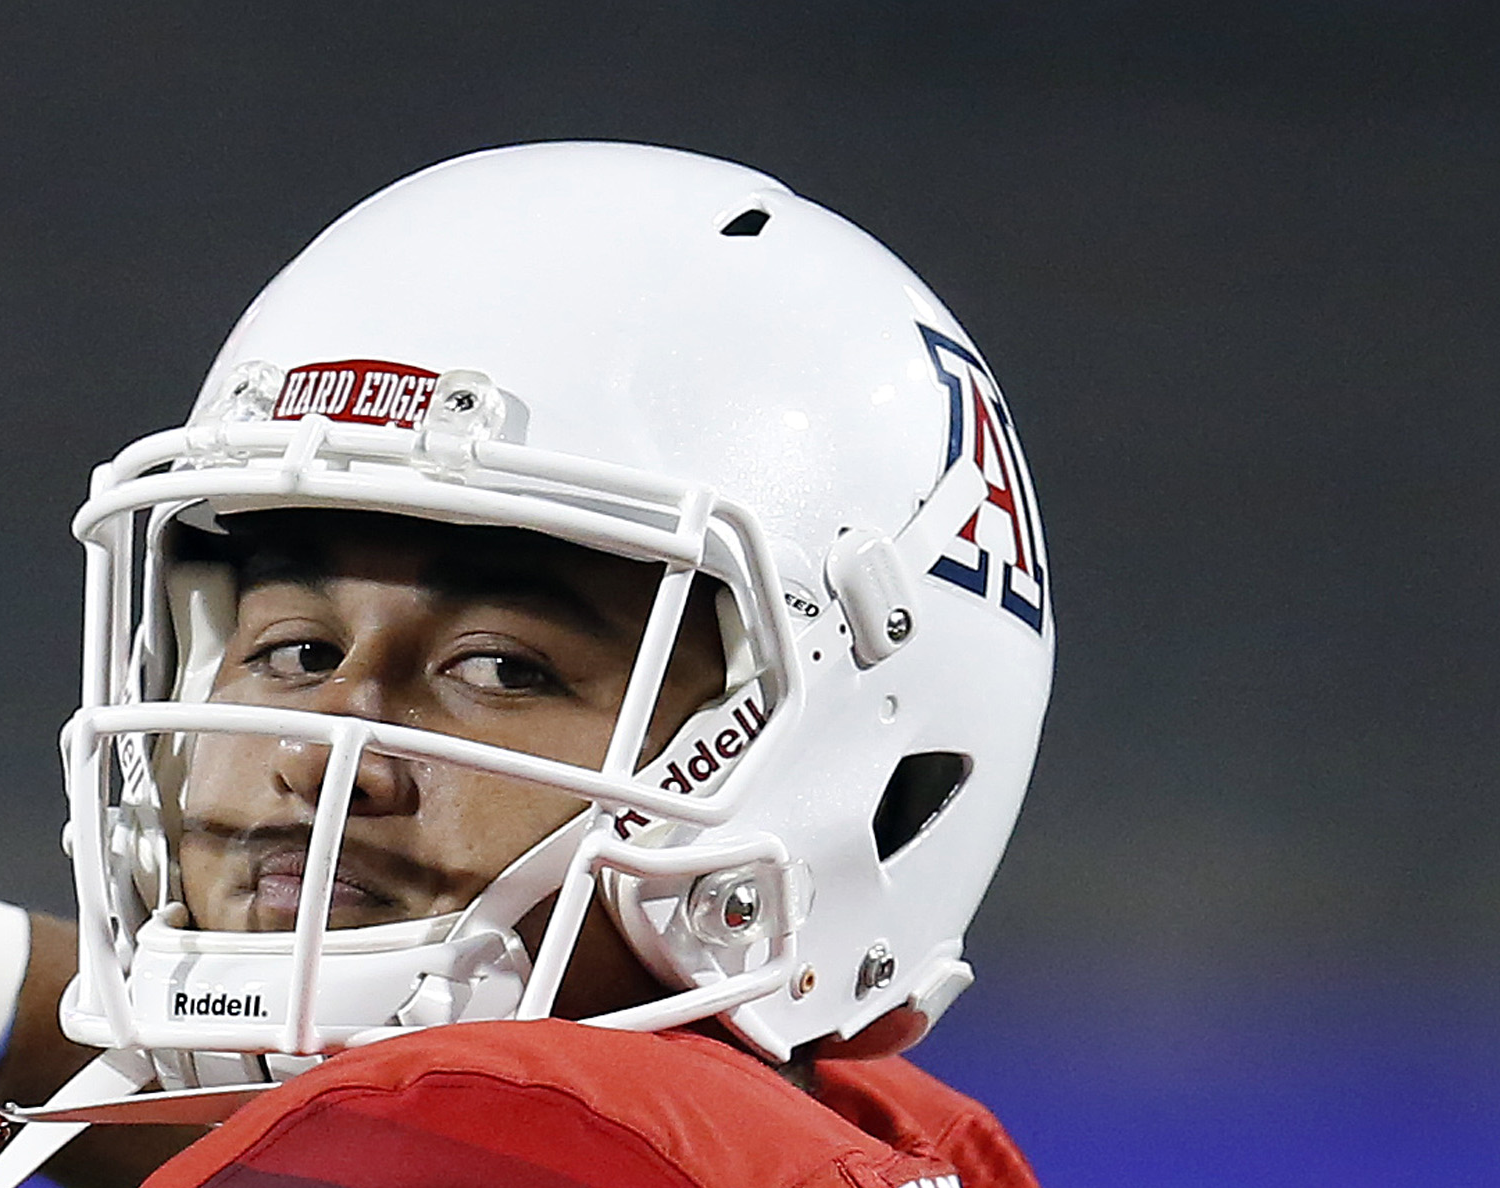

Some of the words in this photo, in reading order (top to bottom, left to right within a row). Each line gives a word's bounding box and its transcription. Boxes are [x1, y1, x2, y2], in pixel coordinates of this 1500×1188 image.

[277, 370, 356, 417] HARD
[352, 371, 436, 422] EDGE
[784, 593, 820, 618] EED
[614, 697, 767, 840] ddell
